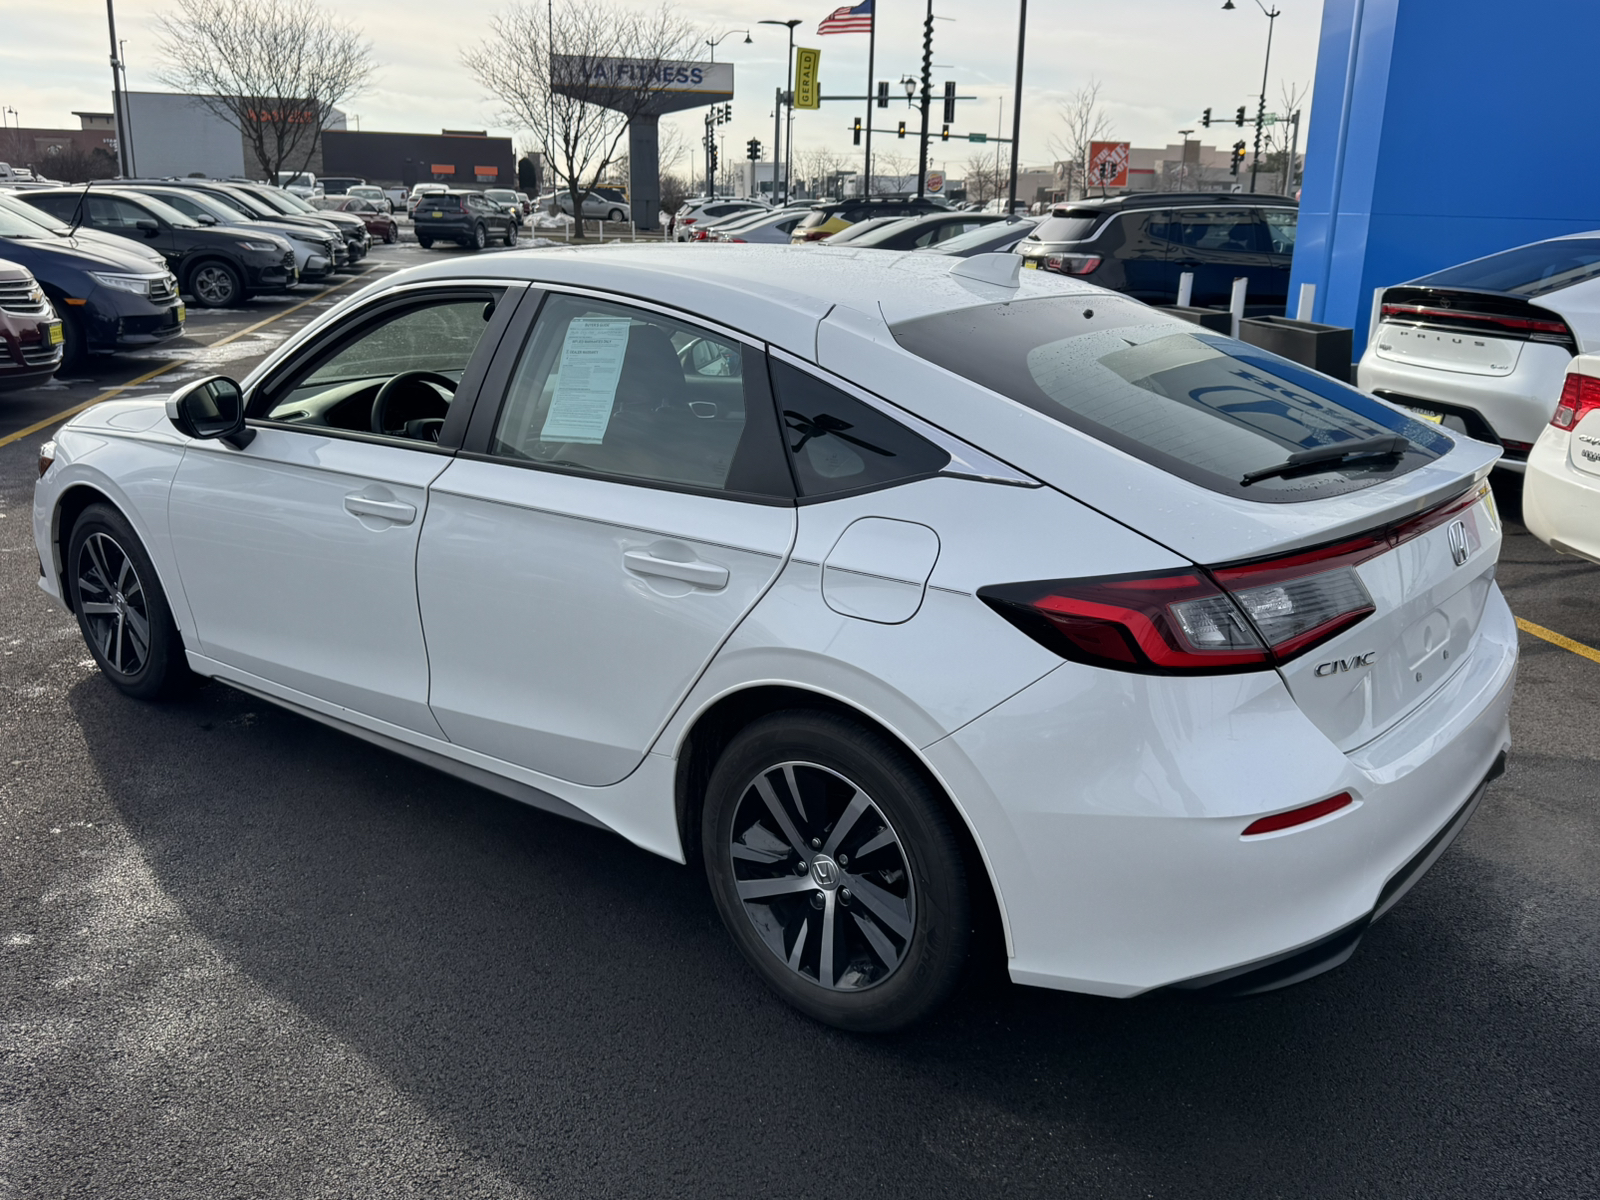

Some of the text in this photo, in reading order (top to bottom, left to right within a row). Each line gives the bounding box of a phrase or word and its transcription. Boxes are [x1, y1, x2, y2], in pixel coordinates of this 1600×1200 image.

[617, 64, 704, 84] FITNESS
[801, 55, 812, 102] GERALD
[1400, 331, 1485, 347] PRIUS
[1314, 651, 1376, 677] CIVIC
